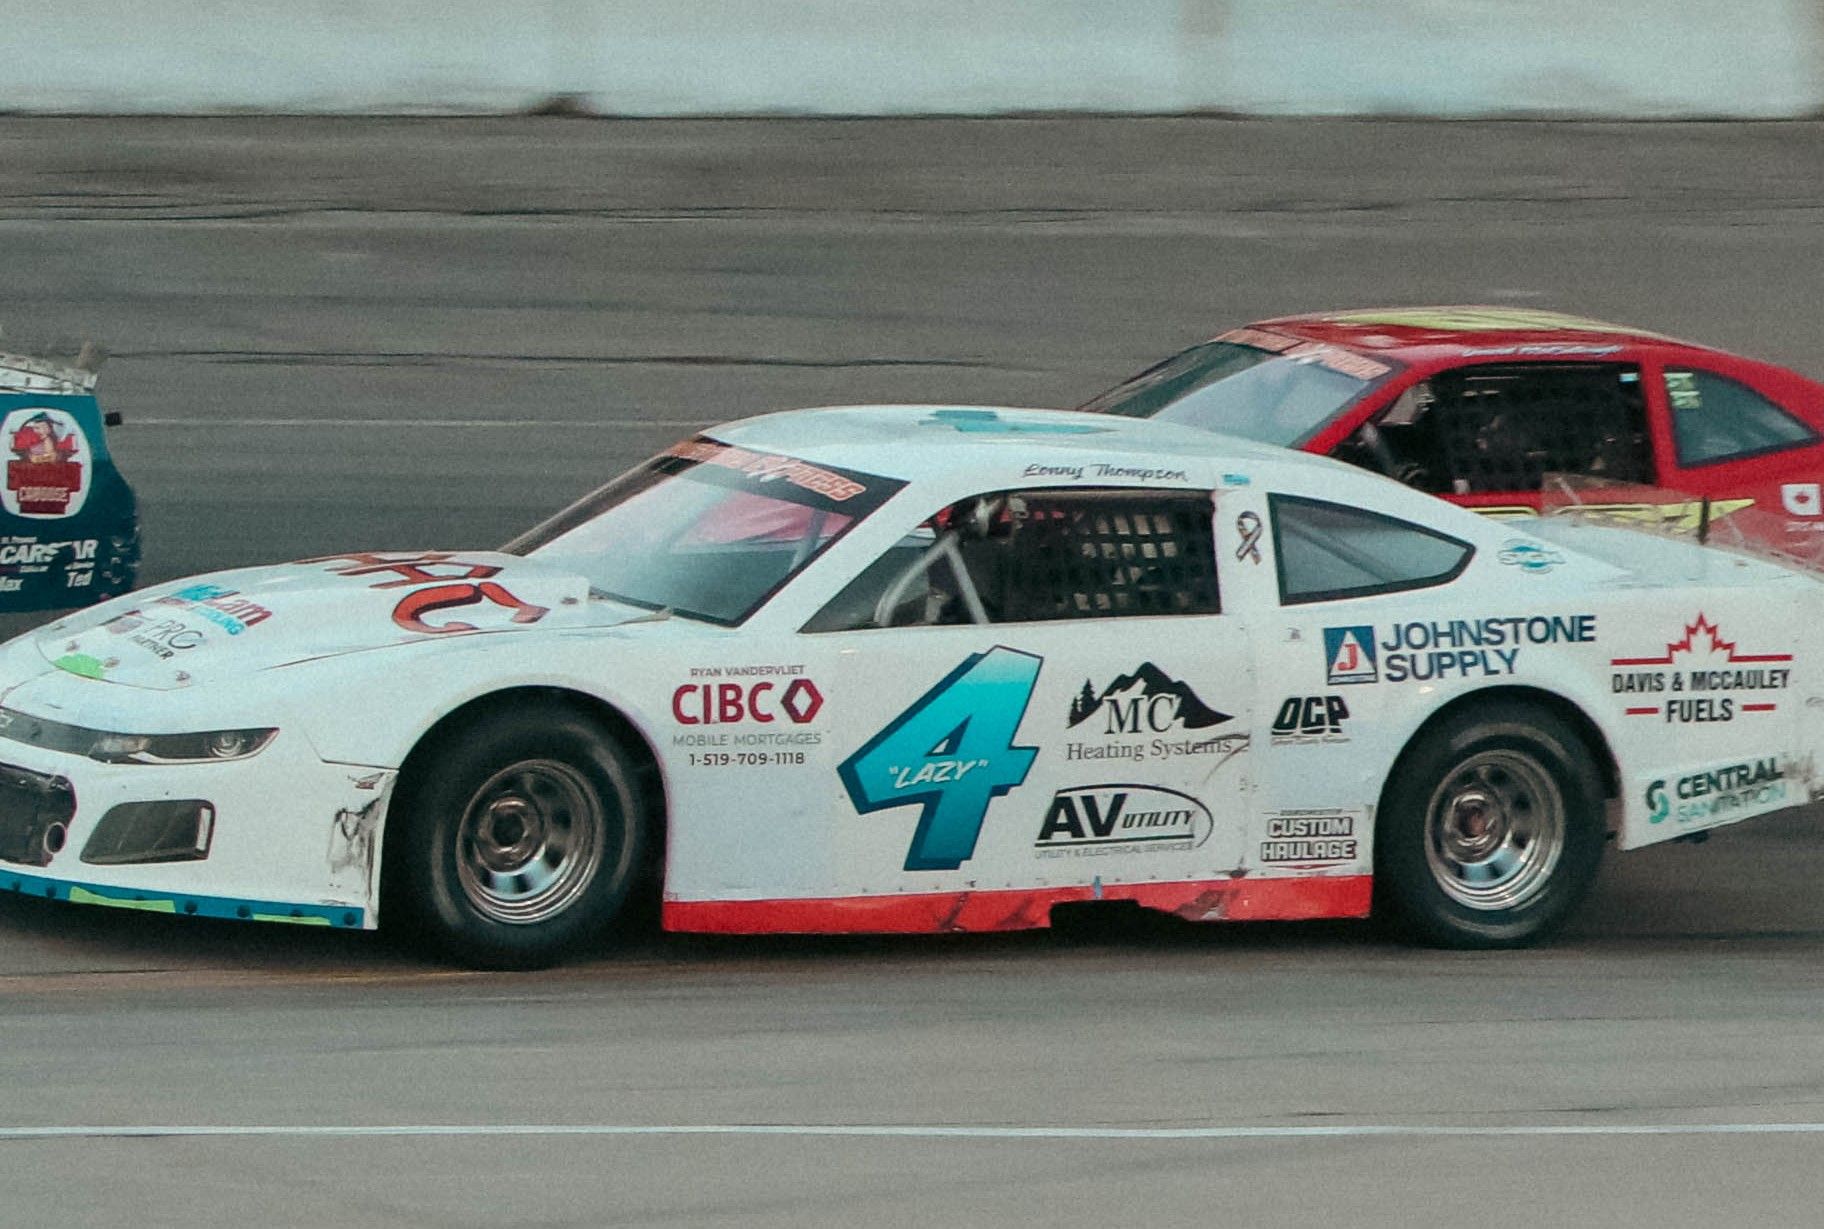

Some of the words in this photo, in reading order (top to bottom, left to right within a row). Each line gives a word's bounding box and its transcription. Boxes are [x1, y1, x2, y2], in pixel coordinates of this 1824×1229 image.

[1382, 614, 1598, 652] JOHNSTONE
[690, 667, 722, 677] RYAN
[725, 664, 805, 676] VANDERVLIET
[1385, 647, 1521, 683] SUPPLY
[1612, 672, 1665, 693] DAVIS
[1671, 672, 1684, 691] &
[1690, 668, 1791, 691] MCCAULEY
[672, 681, 776, 725] CIBC
[1103, 694, 1180, 735] MC
[1666, 698, 1734, 723] FUELS
[673, 734, 729, 747] MOBILE
[734, 732, 822, 745] MORTGAGES
[1067, 742, 1144, 762] Heating
[1151, 738, 1233, 760] Systems
[689, 751, 806, 766] 1-519-709-1118
[836, 644, 1044, 871] 4
[1676, 756, 1785, 800] CENTRAL
[1037, 792, 1128, 841] AV
[1122, 809, 1196, 829] UTILITY
[1267, 816, 1354, 838] CUSTOM
[1260, 840, 1357, 862] HAULAGE
